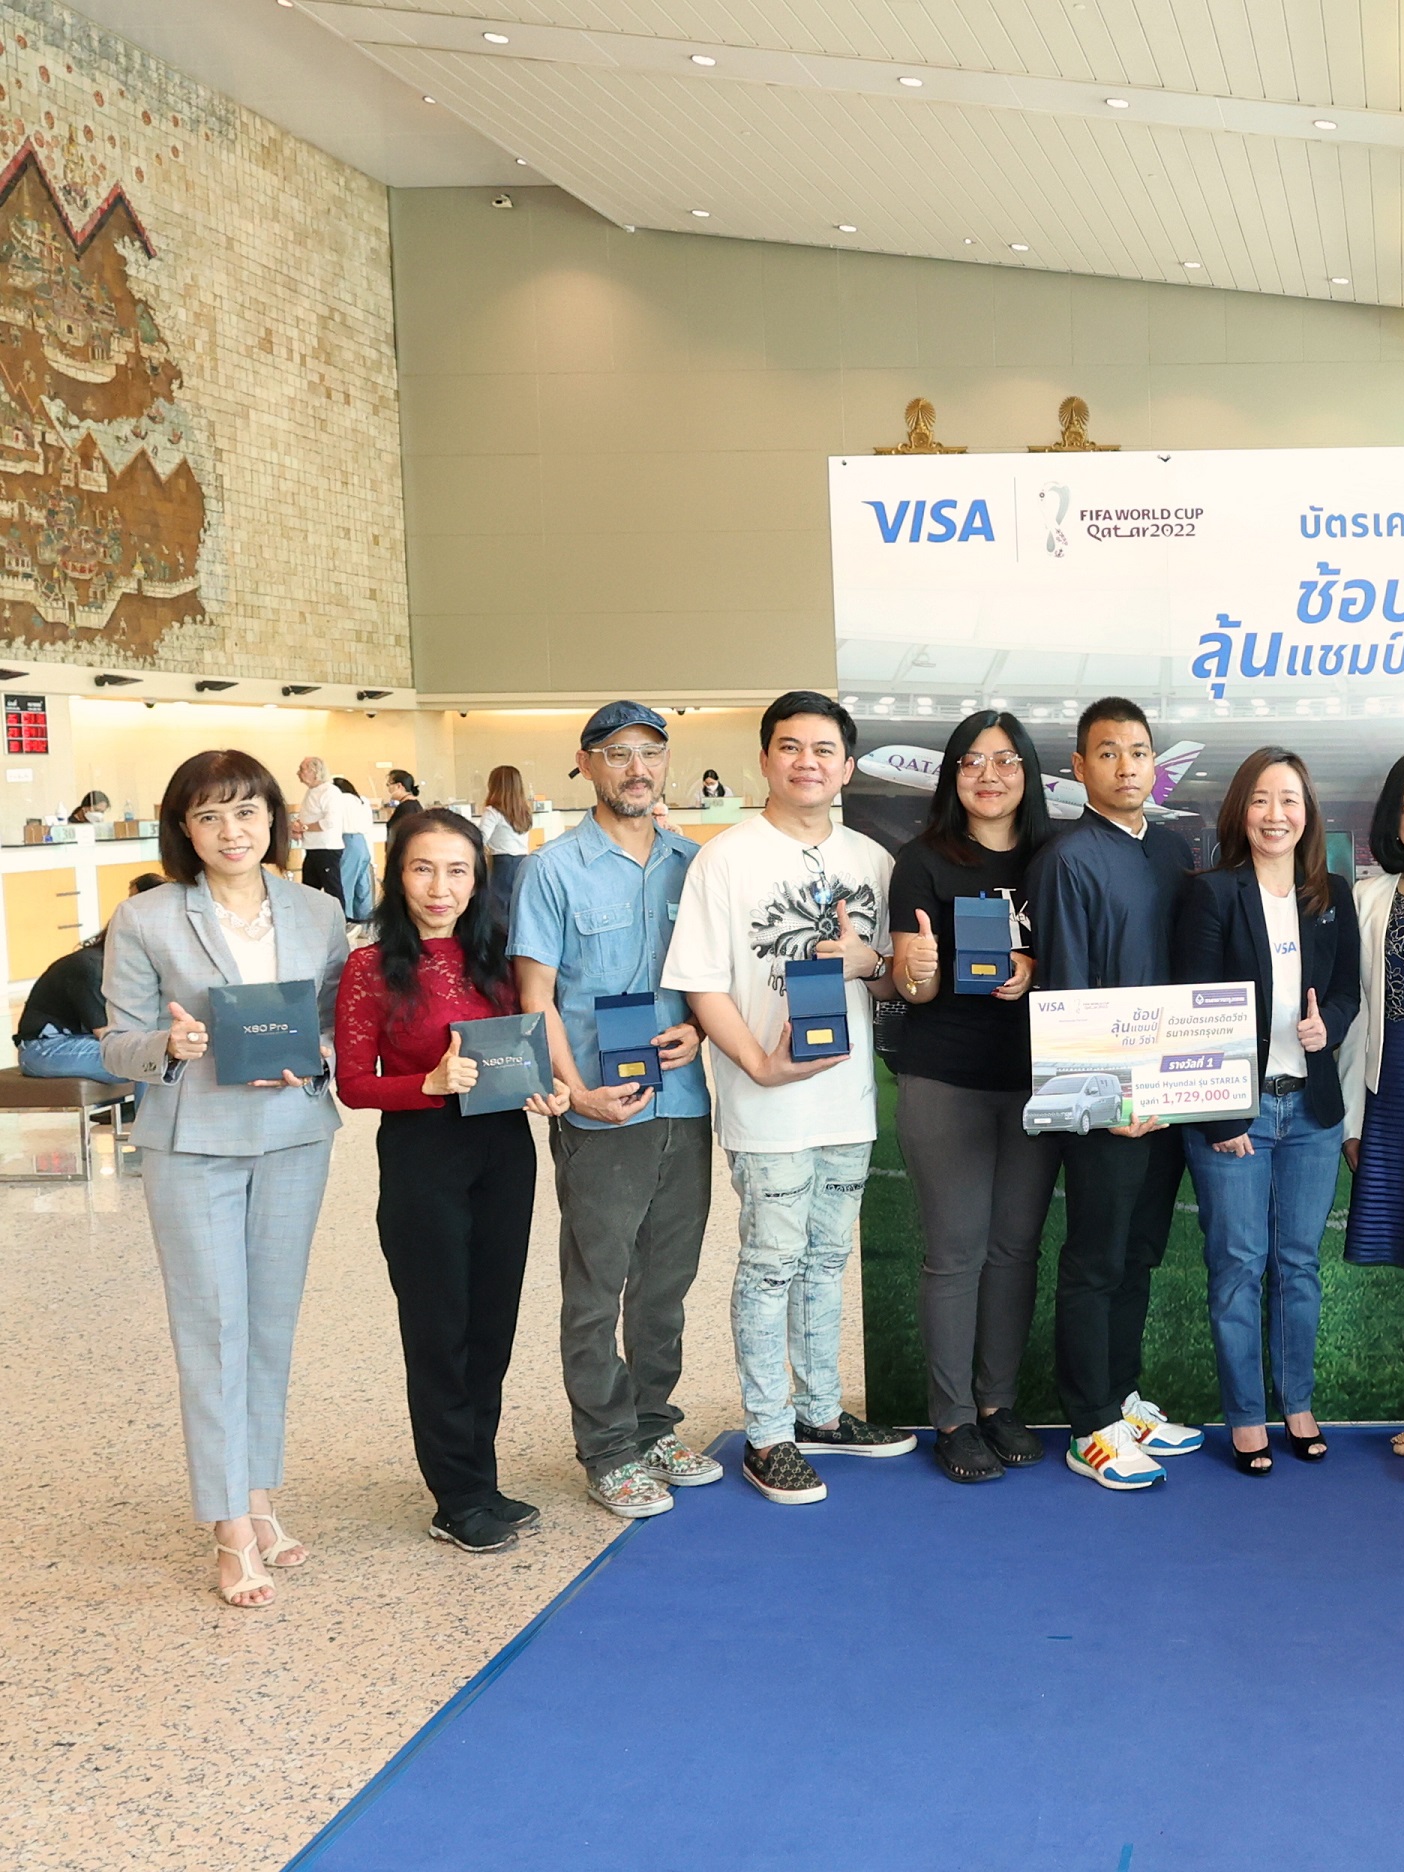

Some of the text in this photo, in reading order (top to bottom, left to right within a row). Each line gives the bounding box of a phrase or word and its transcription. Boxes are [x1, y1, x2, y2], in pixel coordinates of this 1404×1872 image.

[862, 499, 995, 543] VISA
[1080, 508, 1204, 521] FIFA WORLD CUP
[1087, 523, 1196, 542] Qatar2022
[888, 754, 942, 775] QATA
[1038, 1002, 1065, 1012] VISA
[1206, 1058, 1214, 1068] 1
[1162, 1080, 1196, 1090] Hyundai
[1210, 1076, 1240, 1085] STARIA
[1162, 1089, 1230, 1105] 1,729,000
